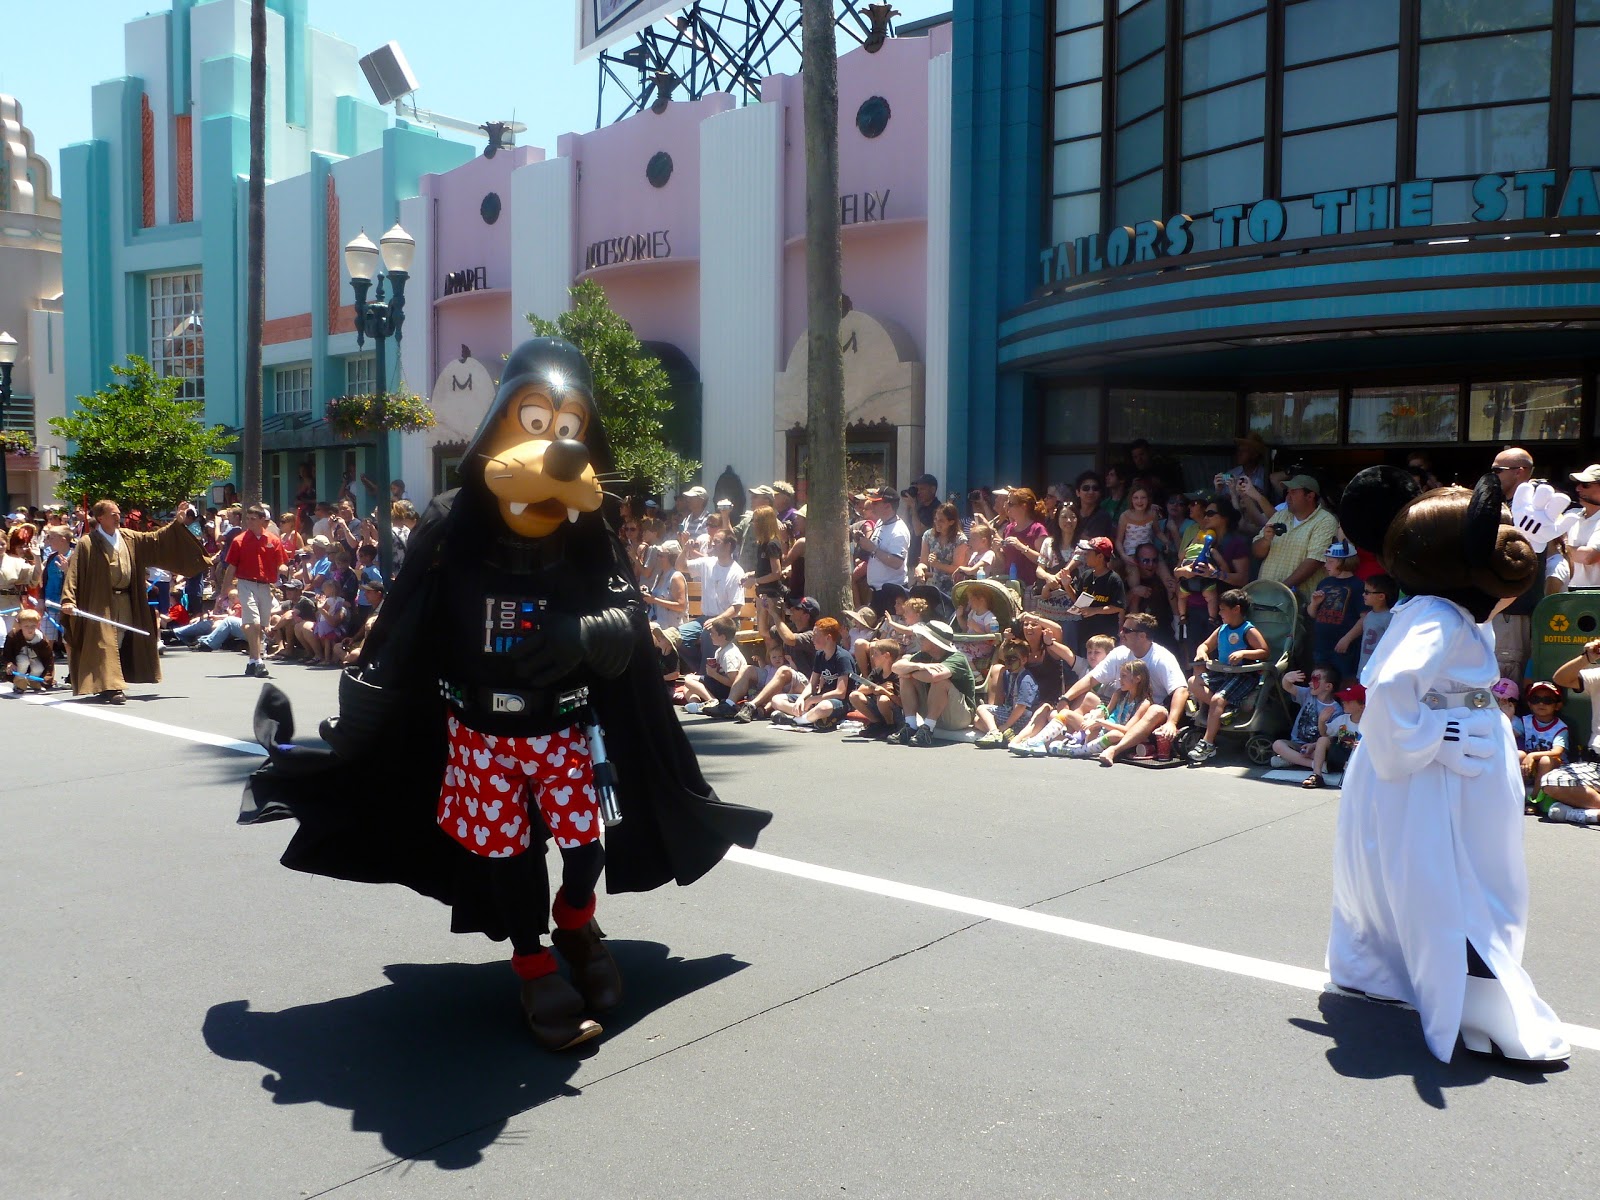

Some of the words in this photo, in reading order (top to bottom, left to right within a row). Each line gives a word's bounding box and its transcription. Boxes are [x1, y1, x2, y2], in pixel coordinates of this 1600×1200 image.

[1040, 213, 1194, 286] TAILORS
[1212, 199, 1287, 248] TO
[1312, 179, 1433, 236] THE
[1471, 167, 1600, 222] STA
[586, 230, 671, 270] ACCESSORIES
[444, 266, 492, 297] APPAREL
[1544, 635, 1571, 643] BOTTLES
